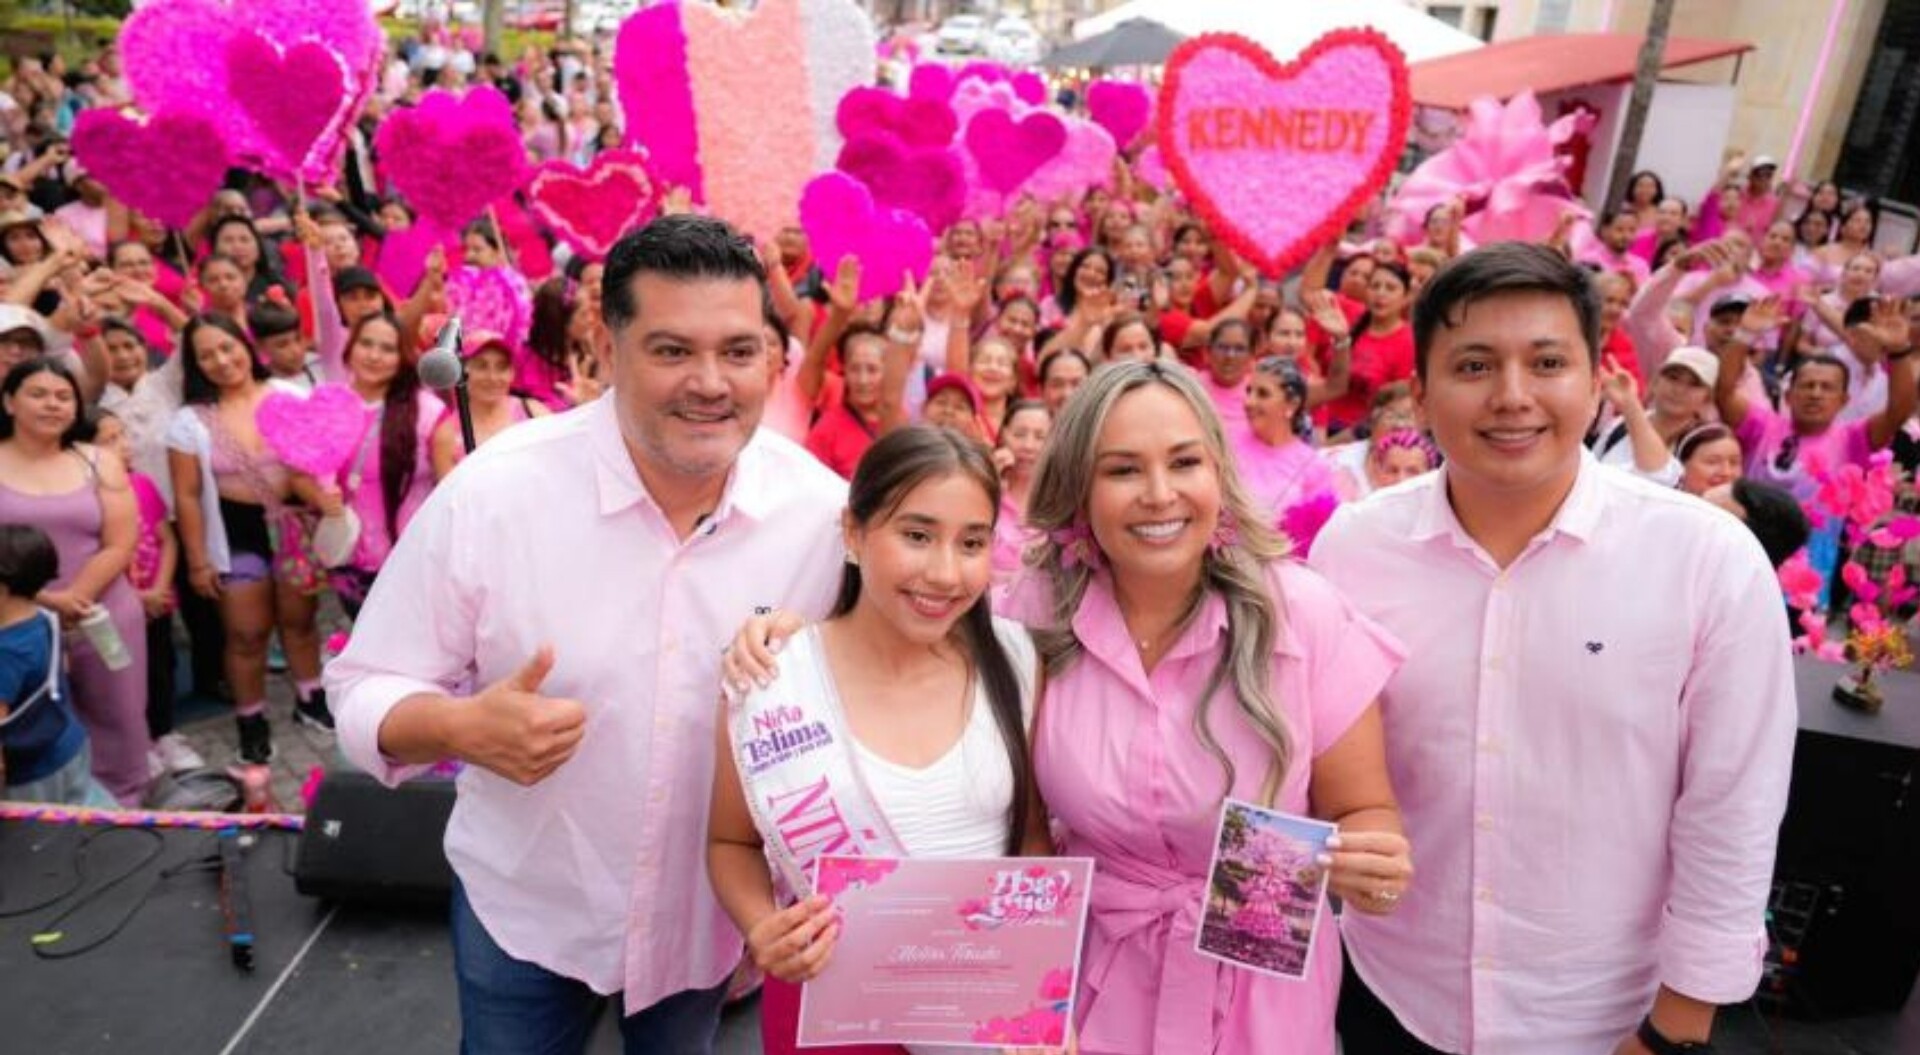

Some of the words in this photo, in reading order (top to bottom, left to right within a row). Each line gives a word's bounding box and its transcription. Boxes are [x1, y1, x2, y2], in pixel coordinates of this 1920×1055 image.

[1187, 107, 1374, 155] KENNEDY
[743, 720, 828, 763] Tolima
[752, 704, 803, 736] Niña
